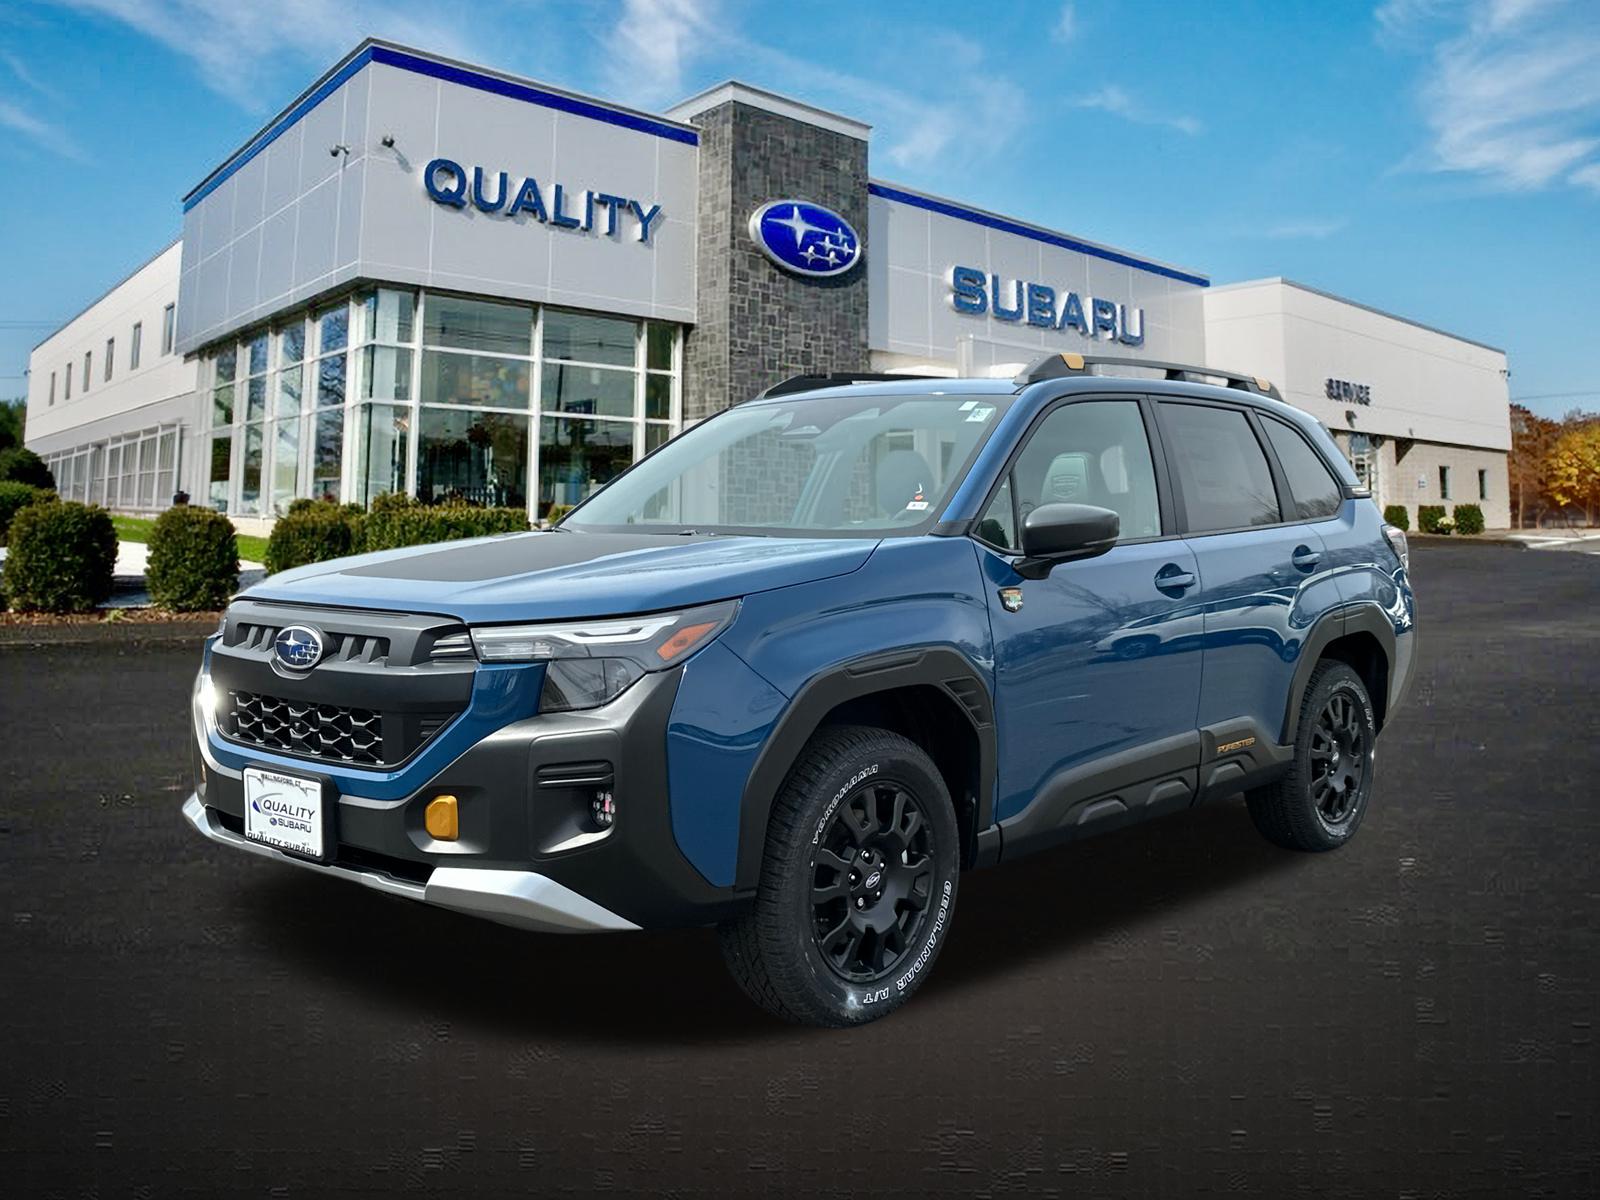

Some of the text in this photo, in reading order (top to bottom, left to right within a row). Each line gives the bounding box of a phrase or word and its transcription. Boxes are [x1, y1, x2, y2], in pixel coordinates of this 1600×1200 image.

[423, 158, 661, 242] QUALITY
[951, 265, 1145, 347] SUBARU
[247, 832, 318, 856] QUALITY SUBARU
[263, 799, 316, 820] QUALITY
[277, 818, 312, 833] SUBARU
[812, 764, 879, 845] YOKOHAMA
[864, 880, 951, 1004] GEOLANDAR A/T
